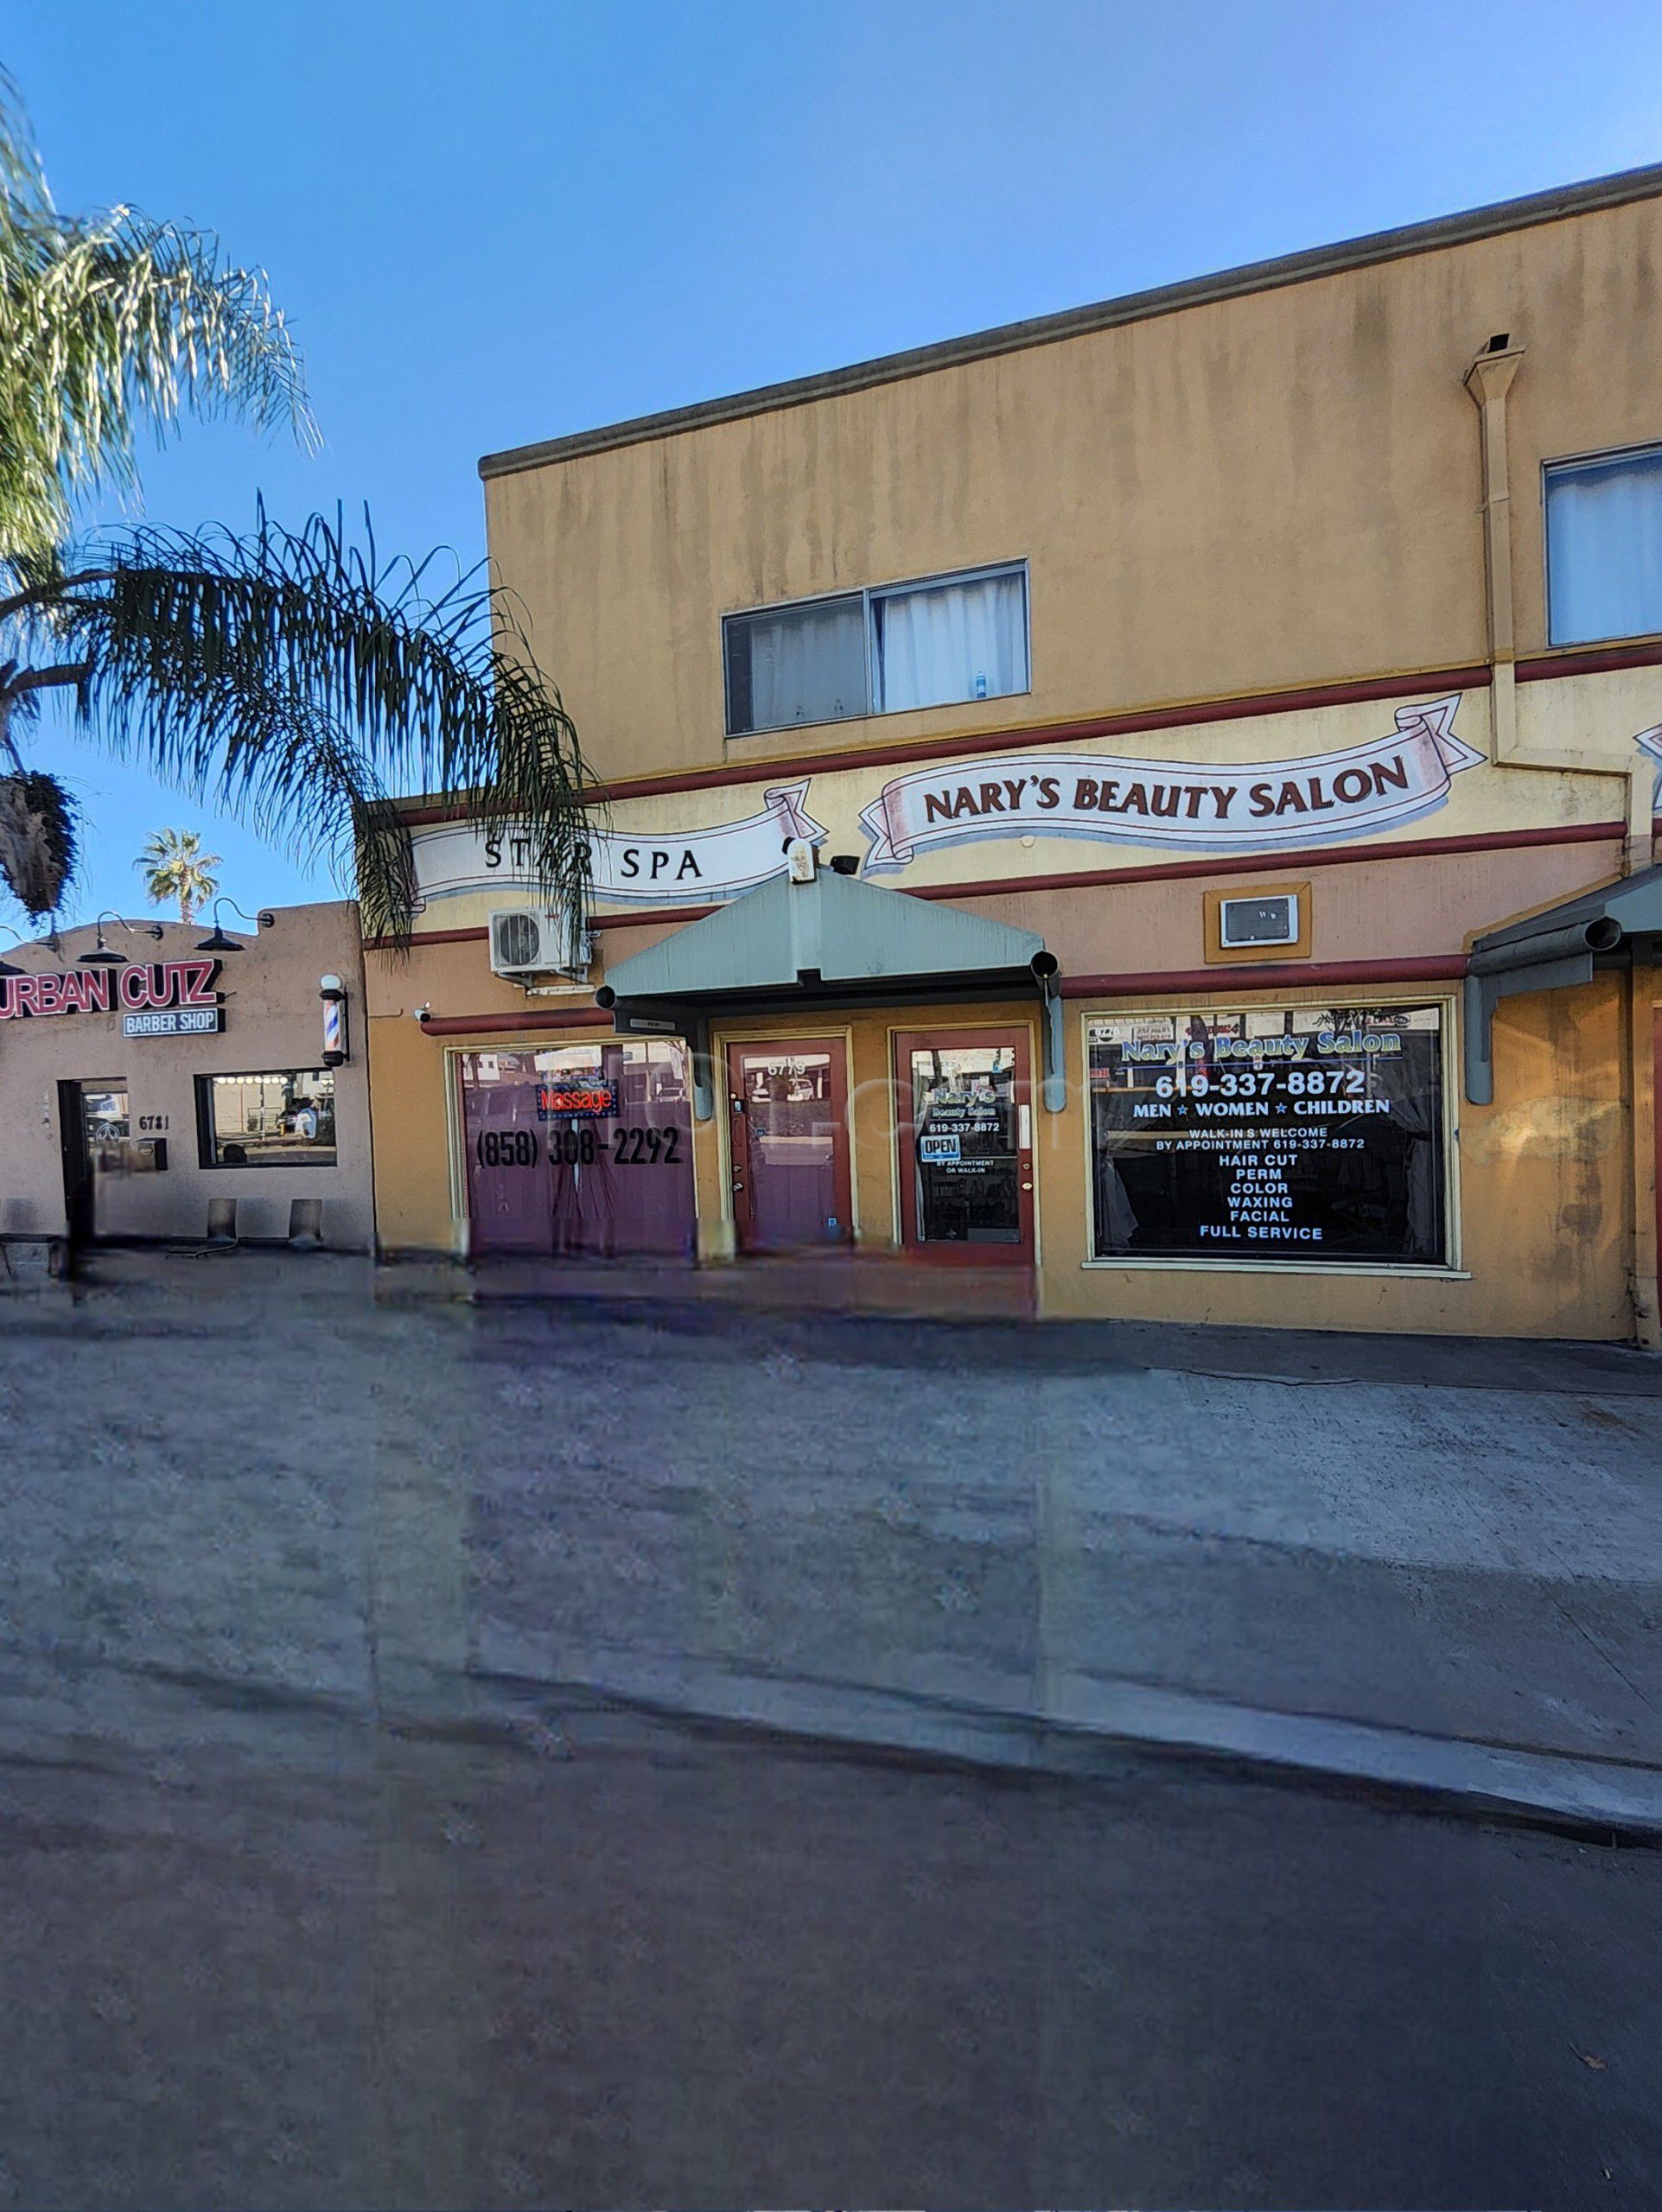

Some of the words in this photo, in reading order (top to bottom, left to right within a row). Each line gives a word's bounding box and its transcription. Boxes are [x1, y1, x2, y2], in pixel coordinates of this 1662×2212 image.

[924, 774, 1060, 823] NARY'S
[1073, 779, 1238, 819] BEAUTY
[1249, 754, 1410, 818] SALON
[621, 849, 703, 880] SPA
[0, 968, 110, 1020] URBAN
[119, 958, 217, 1009] CUTZ
[125, 1014, 176, 1033] BARBER
[180, 1012, 214, 1031] SHOP
[1121, 1036, 1205, 1065] Nary's
[1213, 1036, 1309, 1060] Beauty
[1316, 1031, 1402, 1054] Salon
[767, 1062, 806, 1076] 6779
[1156, 1071, 1365, 1098] 619-337-8872
[540, 1089, 612, 1113] Massage
[933, 1087, 996, 1107] Nary's
[1133, 1103, 1172, 1118] MEN
[1195, 1102, 1269, 1116] WOMEN
[1294, 1099, 1391, 1115] CHILDREN
[139, 1115, 169, 1130] 6781
[929, 1122, 1000, 1133] 619-337-8872
[1259, 1128, 1328, 1138] WELCOME
[477, 1128, 538, 1168] (858)
[548, 1126, 683, 1166] 308-2292
[925, 1137, 957, 1154] OPEN
[1156, 1141, 1173, 1150] BY
[1175, 1140, 1269, 1150] APPOINTMENT
[1273, 1139, 1365, 1149] 619-337-8872
[1219, 1154, 1258, 1166] HAIR
[1264, 1154, 1298, 1166] CUT
[1236, 1168, 1282, 1180] PERM
[1230, 1183, 1289, 1194] COLOR
[1227, 1197, 1294, 1208] WAXING
[1230, 1211, 1289, 1222] FACIAL
[1200, 1225, 1241, 1237] FULL
[1247, 1226, 1323, 1240] SERVICE
